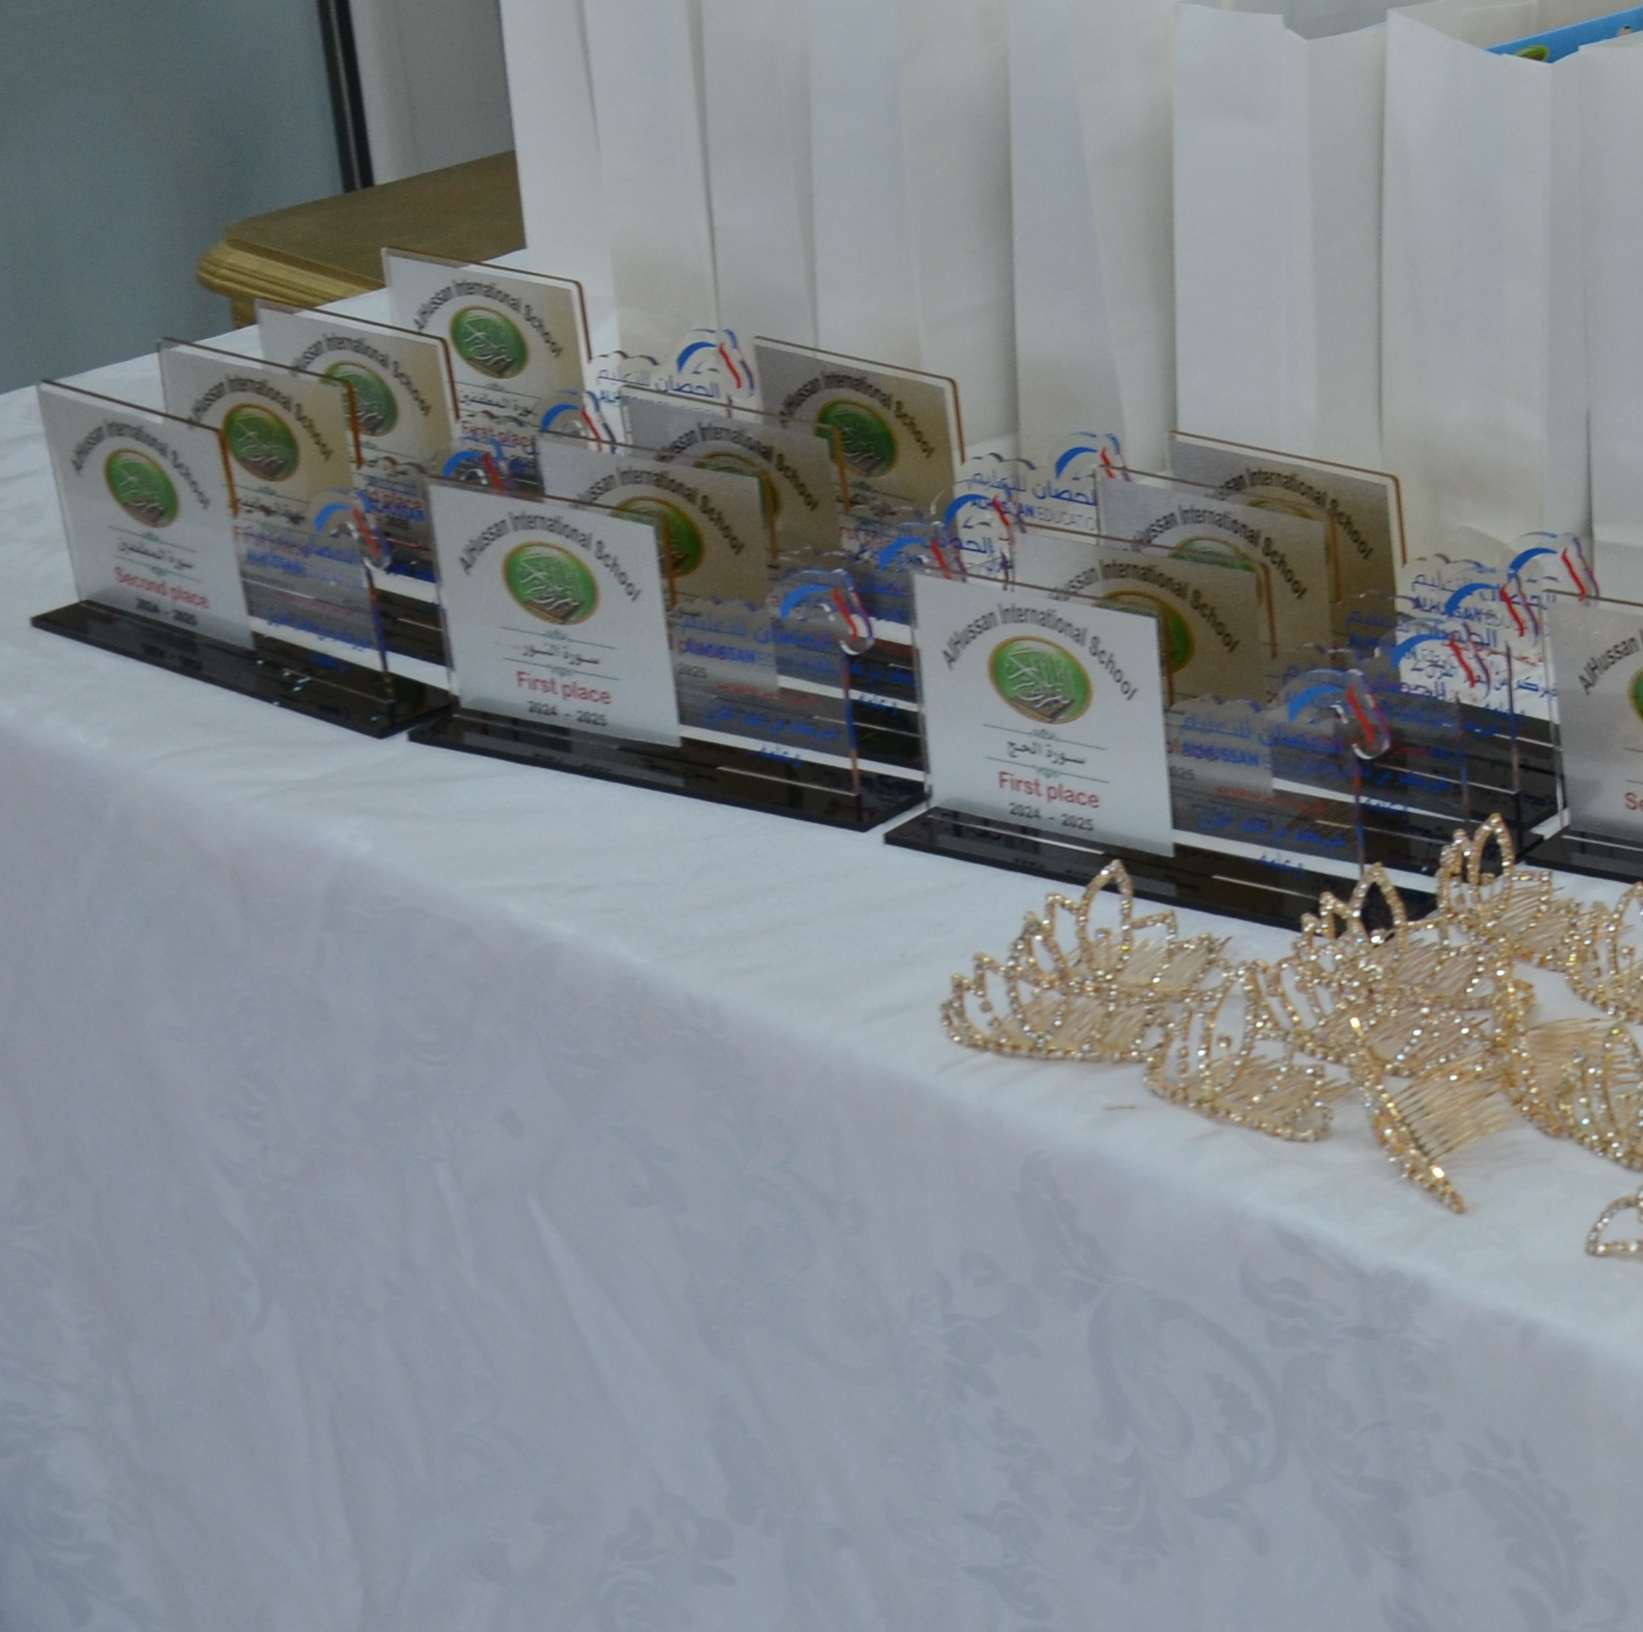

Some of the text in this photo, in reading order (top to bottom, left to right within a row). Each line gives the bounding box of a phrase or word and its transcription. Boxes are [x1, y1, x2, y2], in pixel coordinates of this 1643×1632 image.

[508, 511, 594, 551] International
[594, 539, 642, 603] School
[1190, 589, 1240, 652] School
[997, 601, 1089, 647] International
[1088, 634, 1139, 701] School
[515, 670, 612, 705] First place
[998, 770, 1100, 809] First place
[1009, 802, 1042, 819] 2024
[1061, 813, 1095, 832] 2025
